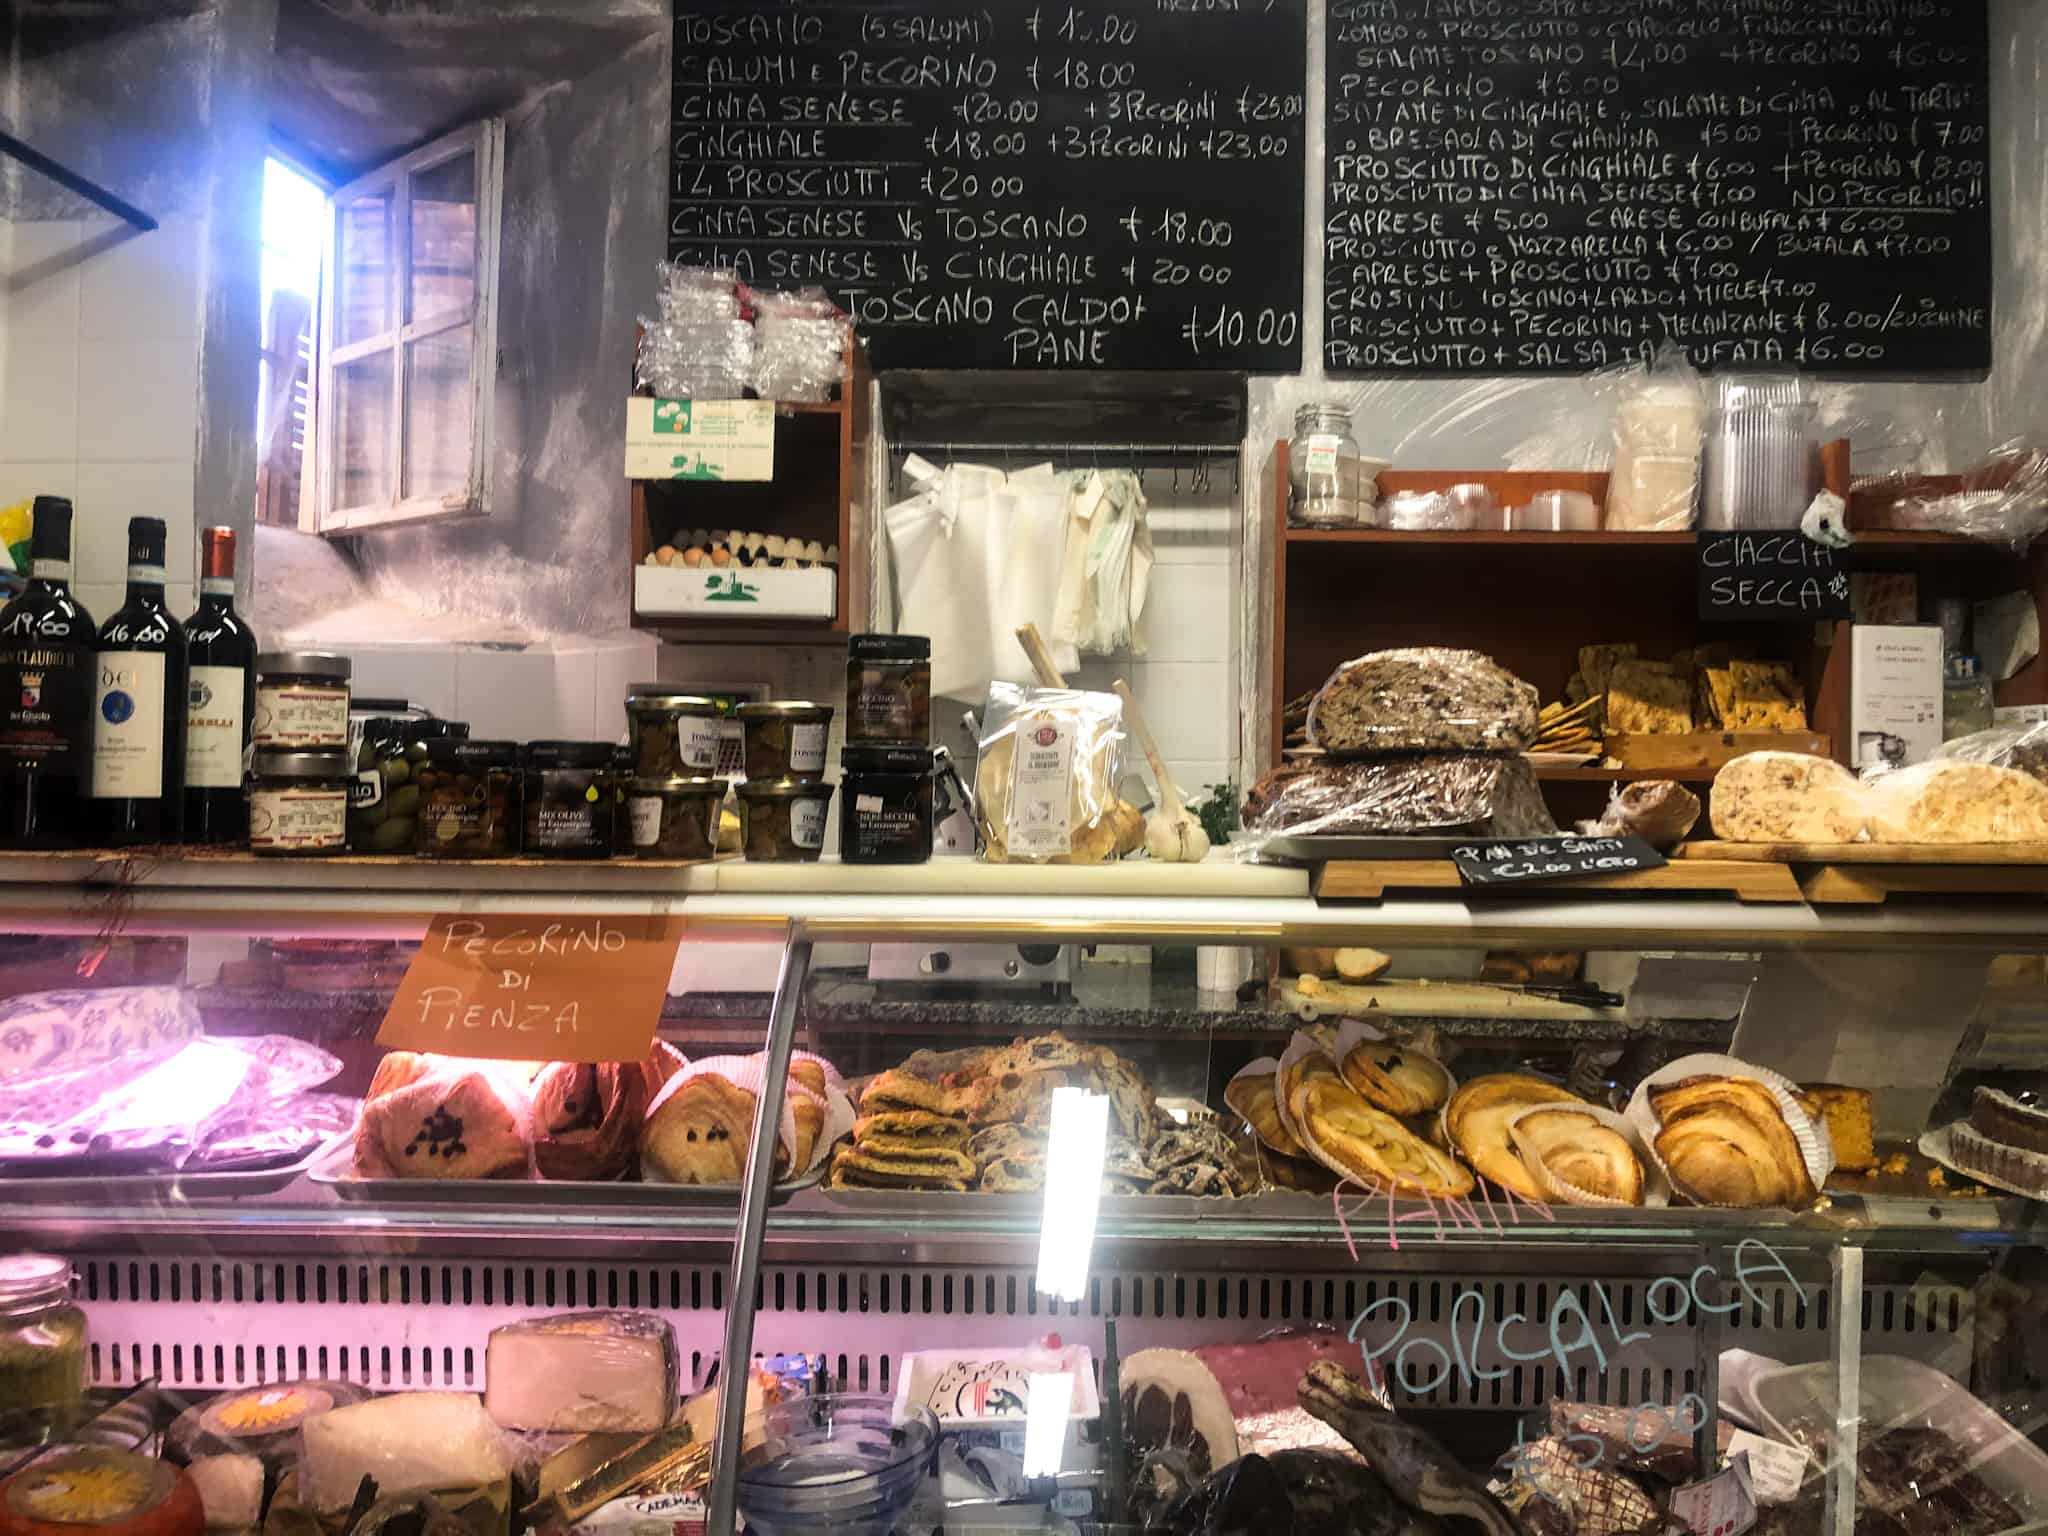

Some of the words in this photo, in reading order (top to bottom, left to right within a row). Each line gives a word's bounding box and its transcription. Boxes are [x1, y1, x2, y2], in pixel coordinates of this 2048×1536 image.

[838, 50, 997, 88] PECORINO
[1461, 43, 1584, 66] TOSANO
[1340, 69, 1494, 98] PECORINO
[682, 88, 767, 120] CINTA
[778, 91, 905, 122] SENESE
[675, 124, 826, 158] CINGHIALE
[727, 164, 890, 197] PROSCIUTTI
[1334, 151, 1501, 181] PROSCIUTTO
[1542, 149, 1673, 181] CINGHIALE
[1801, 148, 1901, 179] PECORINO
[1331, 180, 1473, 203] PROSCIUTTO
[1600, 182, 1687, 203] SENESE
[1793, 183, 1836, 207] NO
[671, 205, 757, 236] CINTA
[765, 207, 866, 238] SENESE
[936, 205, 1088, 242] TOSCANO
[1328, 208, 1444, 236] CAPRESE
[1328, 234, 1476, 261] PROSCIUTTO
[767, 248, 880, 281] SENESE
[945, 245, 1098, 286] CINGHIALE
[1328, 259, 1453, 285] CAPRESE
[1490, 257, 1650, 285] PROSCIUTTO
[838, 286, 993, 326] TOSCANO
[1510, 307, 1631, 337] PECORINO
[1658, 309, 1788, 336] MELANZANE
[1004, 328, 1110, 364] PANE
[1325, 337, 1485, 366] PROSCIUTTO
[1518, 343, 1607, 365] SALSA
[1711, 576, 1824, 609] SECCA
[442, 920, 626, 956] PECORINO
[498, 961, 532, 991] DI
[417, 986, 580, 1033] PIENZA
